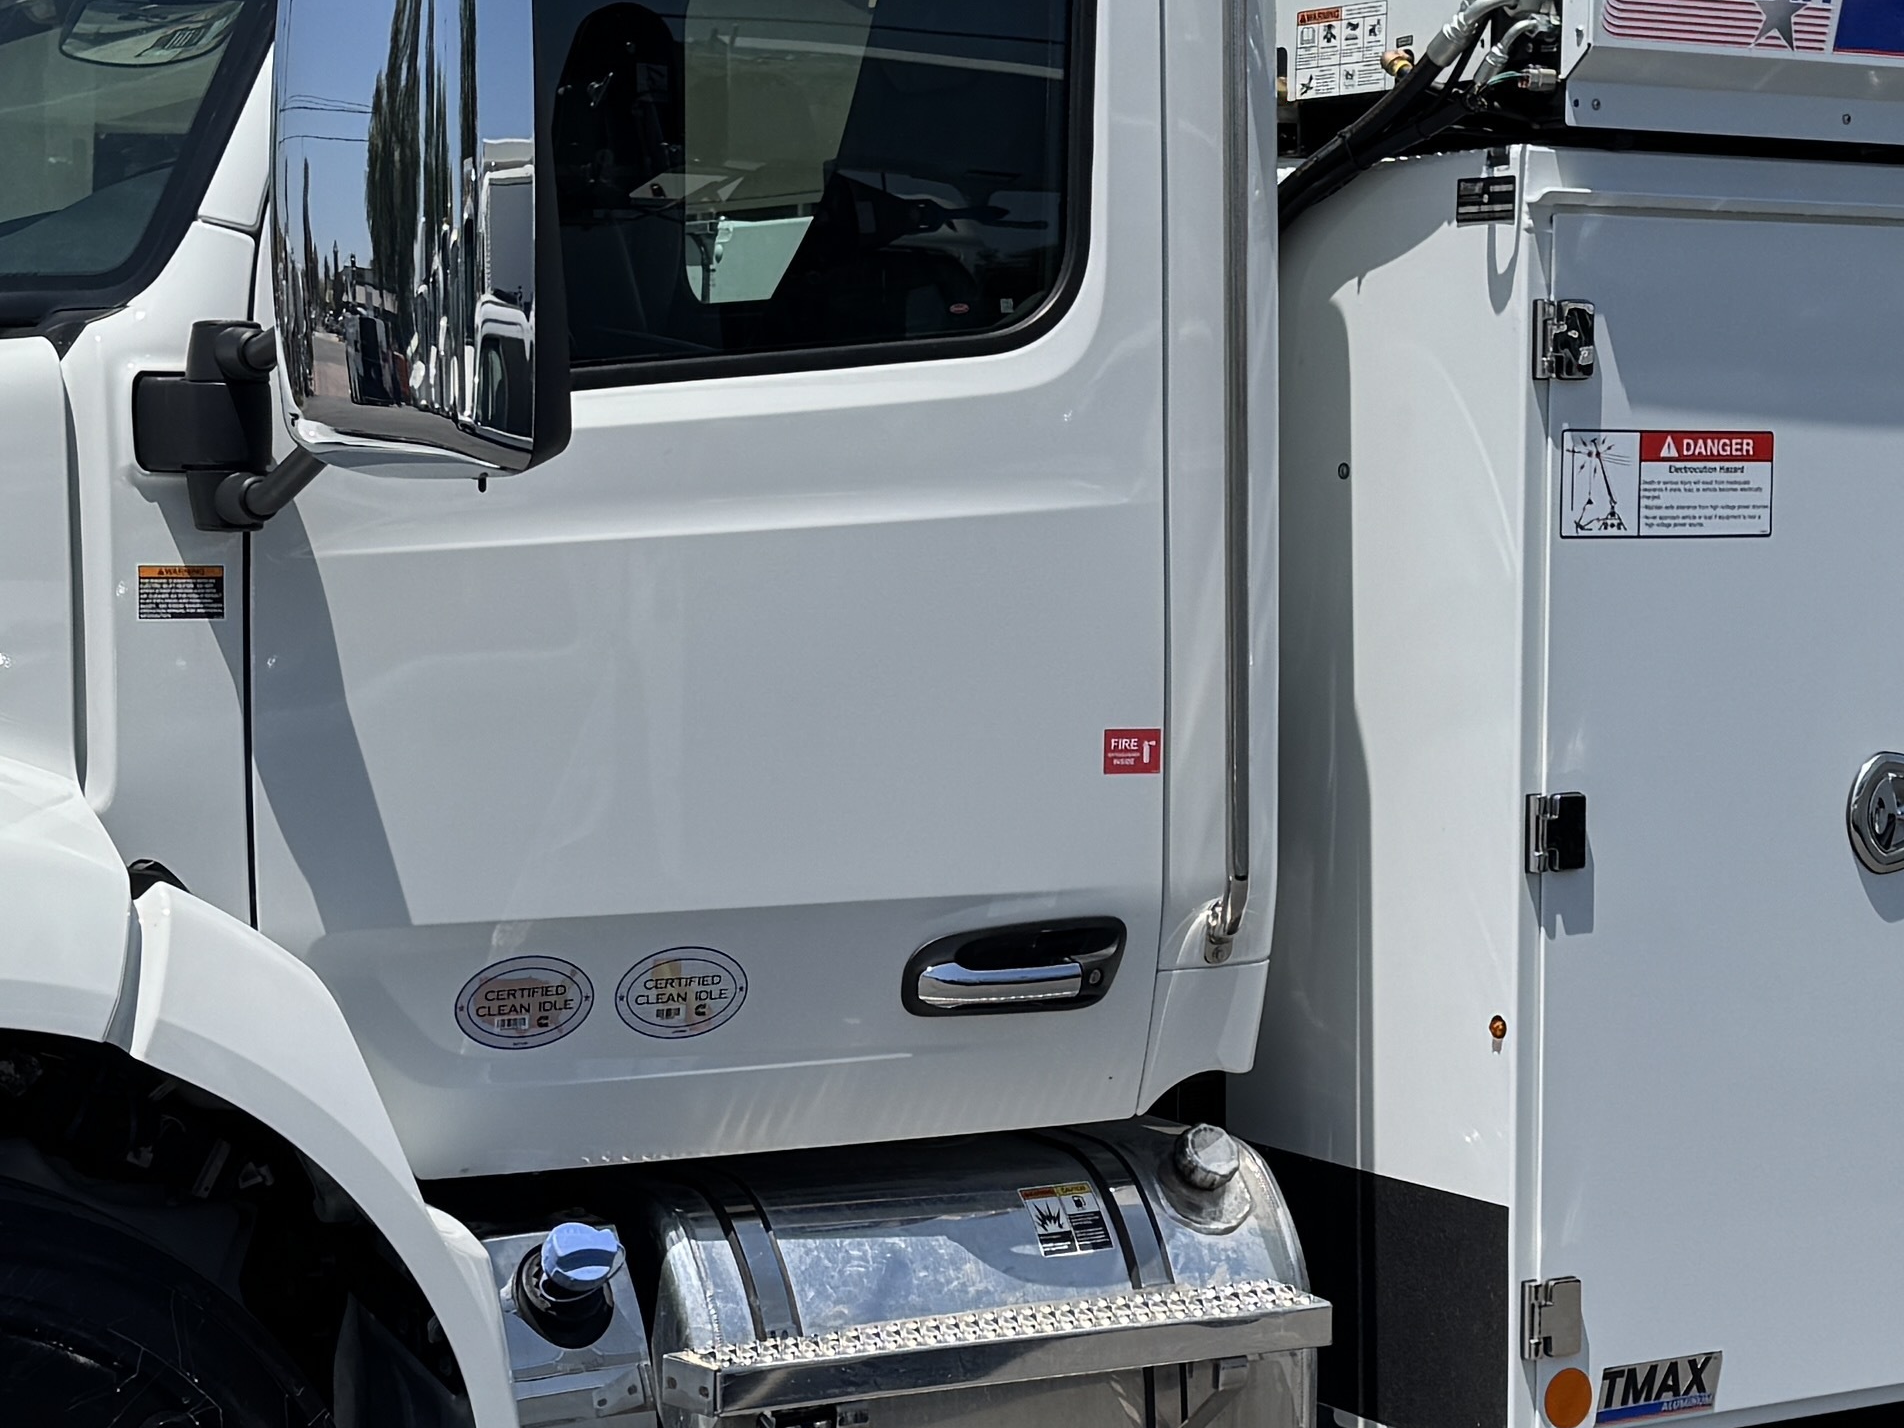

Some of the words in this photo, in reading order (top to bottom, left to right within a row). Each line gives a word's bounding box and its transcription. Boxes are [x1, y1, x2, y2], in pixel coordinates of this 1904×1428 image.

[1683, 439, 1754, 455] DANGER
[1111, 738, 1138, 750] FIRE
[643, 974, 722, 990] CERTIFIED
[484, 984, 567, 1002] CERTIFIED
[635, 992, 688, 1006] CLEAN
[695, 988, 730, 1002] IDLE
[476, 1003, 530, 1018] CLEAN
[538, 999, 574, 1013] IDLE
[1603, 1355, 1713, 1408] TMAX
